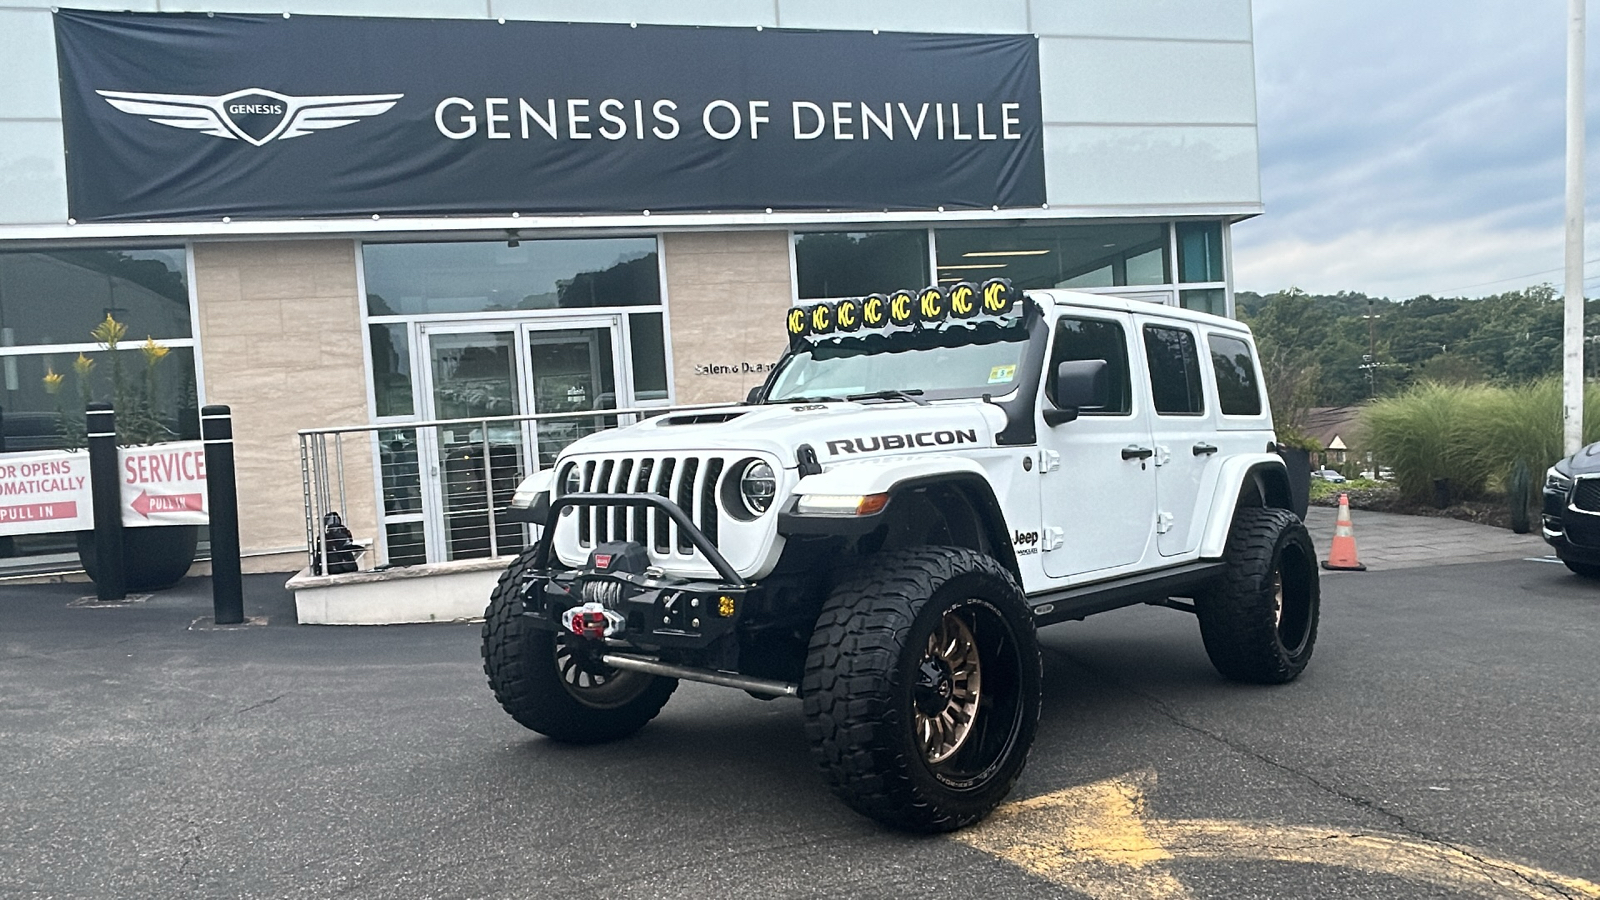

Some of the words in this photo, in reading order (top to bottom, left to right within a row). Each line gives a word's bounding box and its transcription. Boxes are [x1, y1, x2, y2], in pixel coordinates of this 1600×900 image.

[229, 104, 282, 115] GENESIS
[434, 96, 680, 140] GENESIS
[702, 99, 770, 140] OF
[792, 101, 1021, 141] DENVILLE
[891, 294, 911, 321] KC
[921, 291, 941, 318] KC
[951, 286, 973, 314] KC
[984, 282, 1006, 311] KC
[788, 309, 804, 333] KC
[812, 305, 829, 330] KC
[837, 301, 855, 327] KC
[864, 298, 882, 324] KC
[826, 429, 977, 456] RUBICON
[21, 461, 71, 477] OPENS
[125, 451, 207, 484] SERVICE
[0, 507, 34, 520] PULL
[40, 505, 54, 518] IN
[149, 498, 174, 510] PULL
[175, 497, 187, 509] IN
[1013, 529, 1039, 547] Jeep
